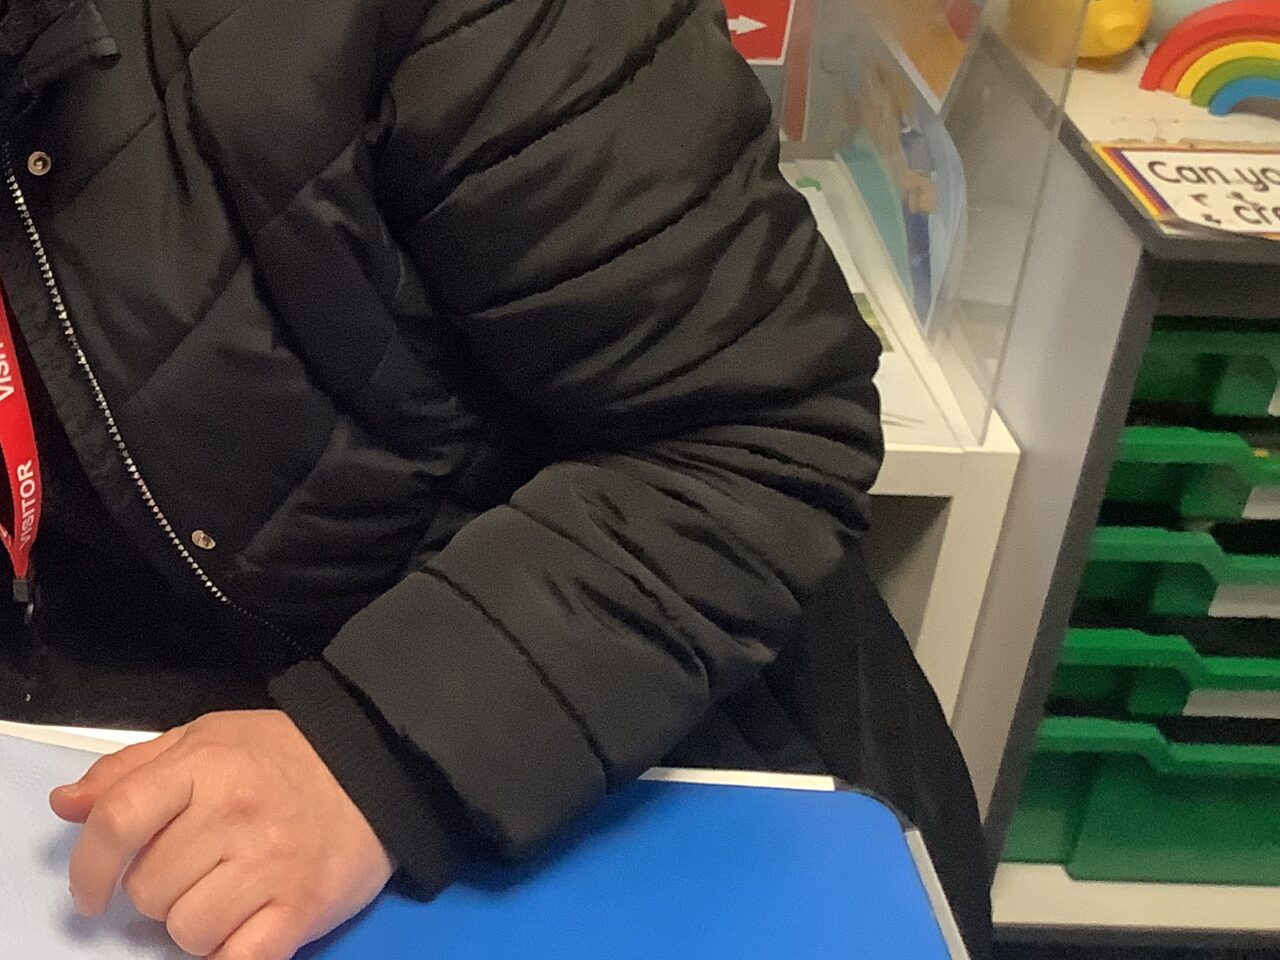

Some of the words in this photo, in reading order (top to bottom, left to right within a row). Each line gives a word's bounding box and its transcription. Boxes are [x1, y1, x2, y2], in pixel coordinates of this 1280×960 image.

[1147, 160, 1231, 185] Can
[1234, 167, 1280, 192] yo
[16, 459, 36, 551] VISITOR
